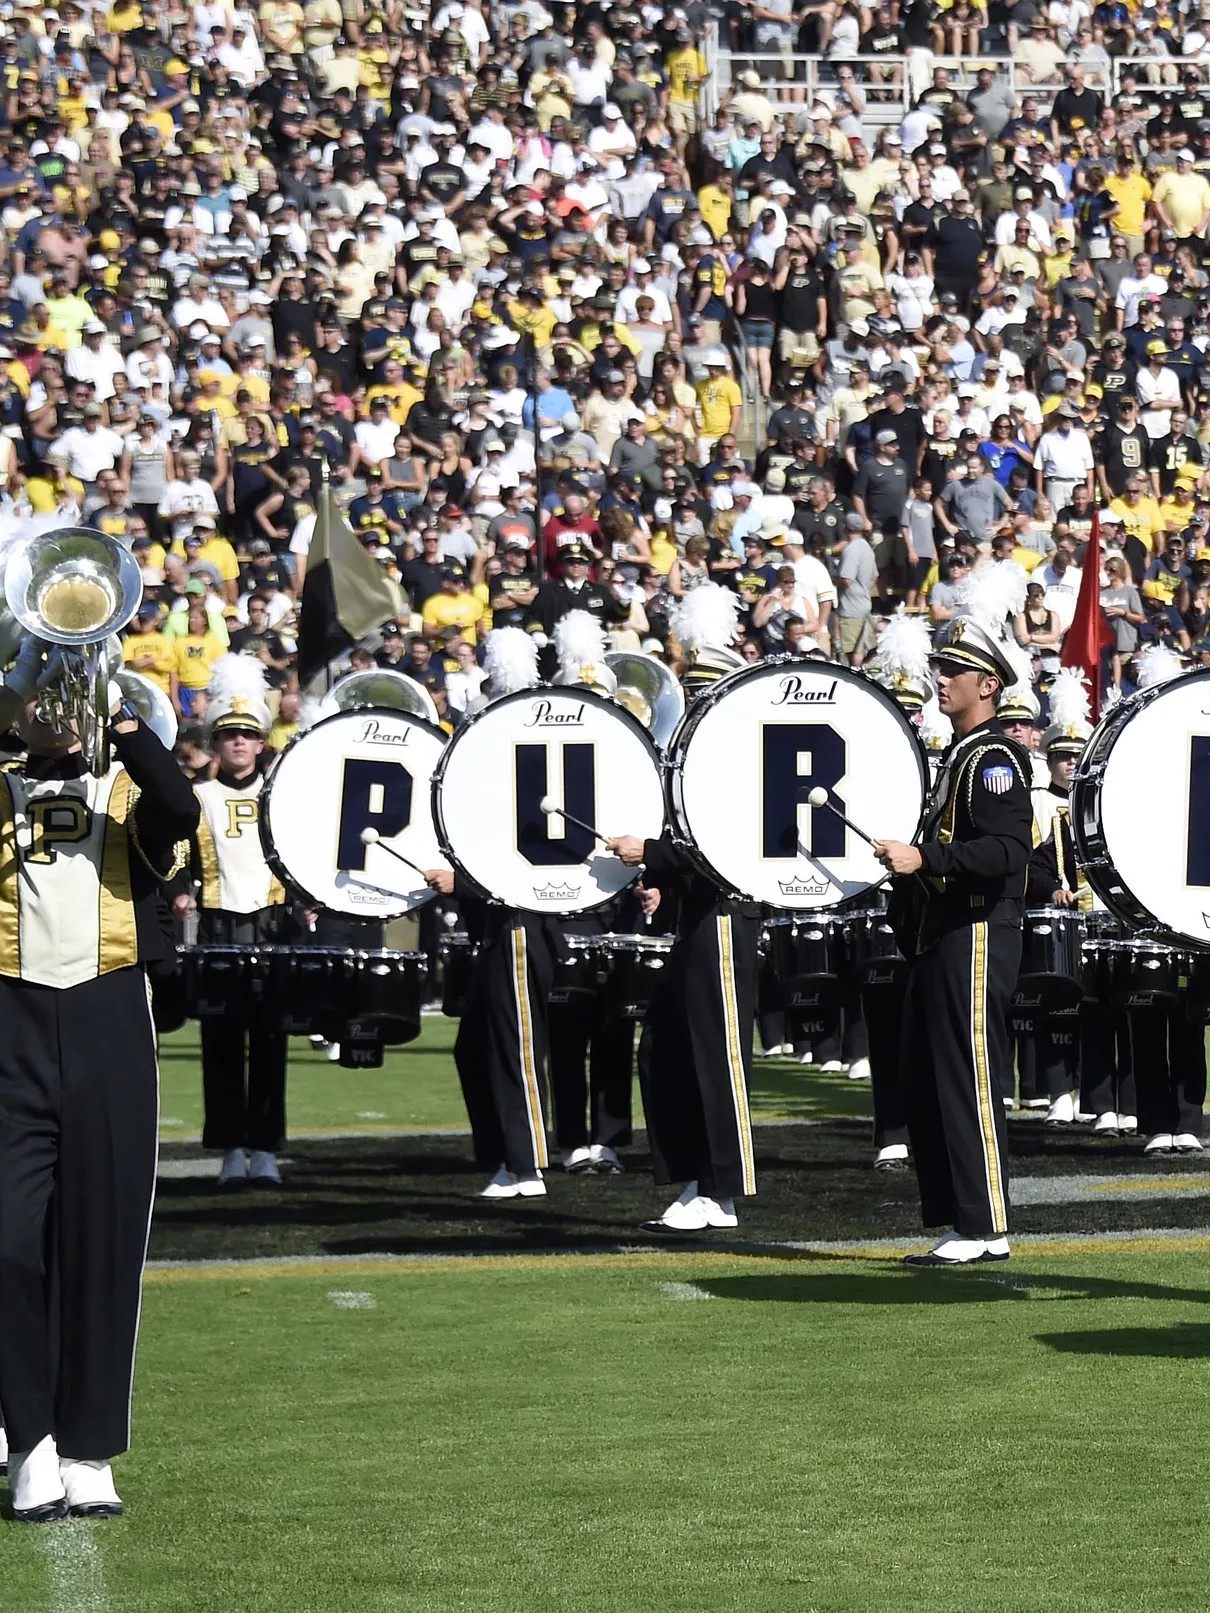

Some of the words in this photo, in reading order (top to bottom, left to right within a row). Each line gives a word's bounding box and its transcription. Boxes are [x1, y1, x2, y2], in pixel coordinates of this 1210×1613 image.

[1103, 374, 1126, 389] P
[1121, 438, 1141, 468] 9
[1165, 445, 1188, 470] 15
[771, 676, 838, 705] Pearl
[524, 700, 585, 727] Pearl
[353, 719, 411, 746] Pearl
[514, 742, 597, 867] U
[761, 722, 848, 860] R
[224, 799, 258, 838] P
[336, 757, 415, 872] P
[26, 795, 92, 865] P
[539, 890, 575, 899] REMO
[785, 885, 825, 894] REMO
[801, 1021, 825, 1033] VIC
[1011, 1019, 1033, 1031] VIC
[1050, 1033, 1073, 1045] VIC
